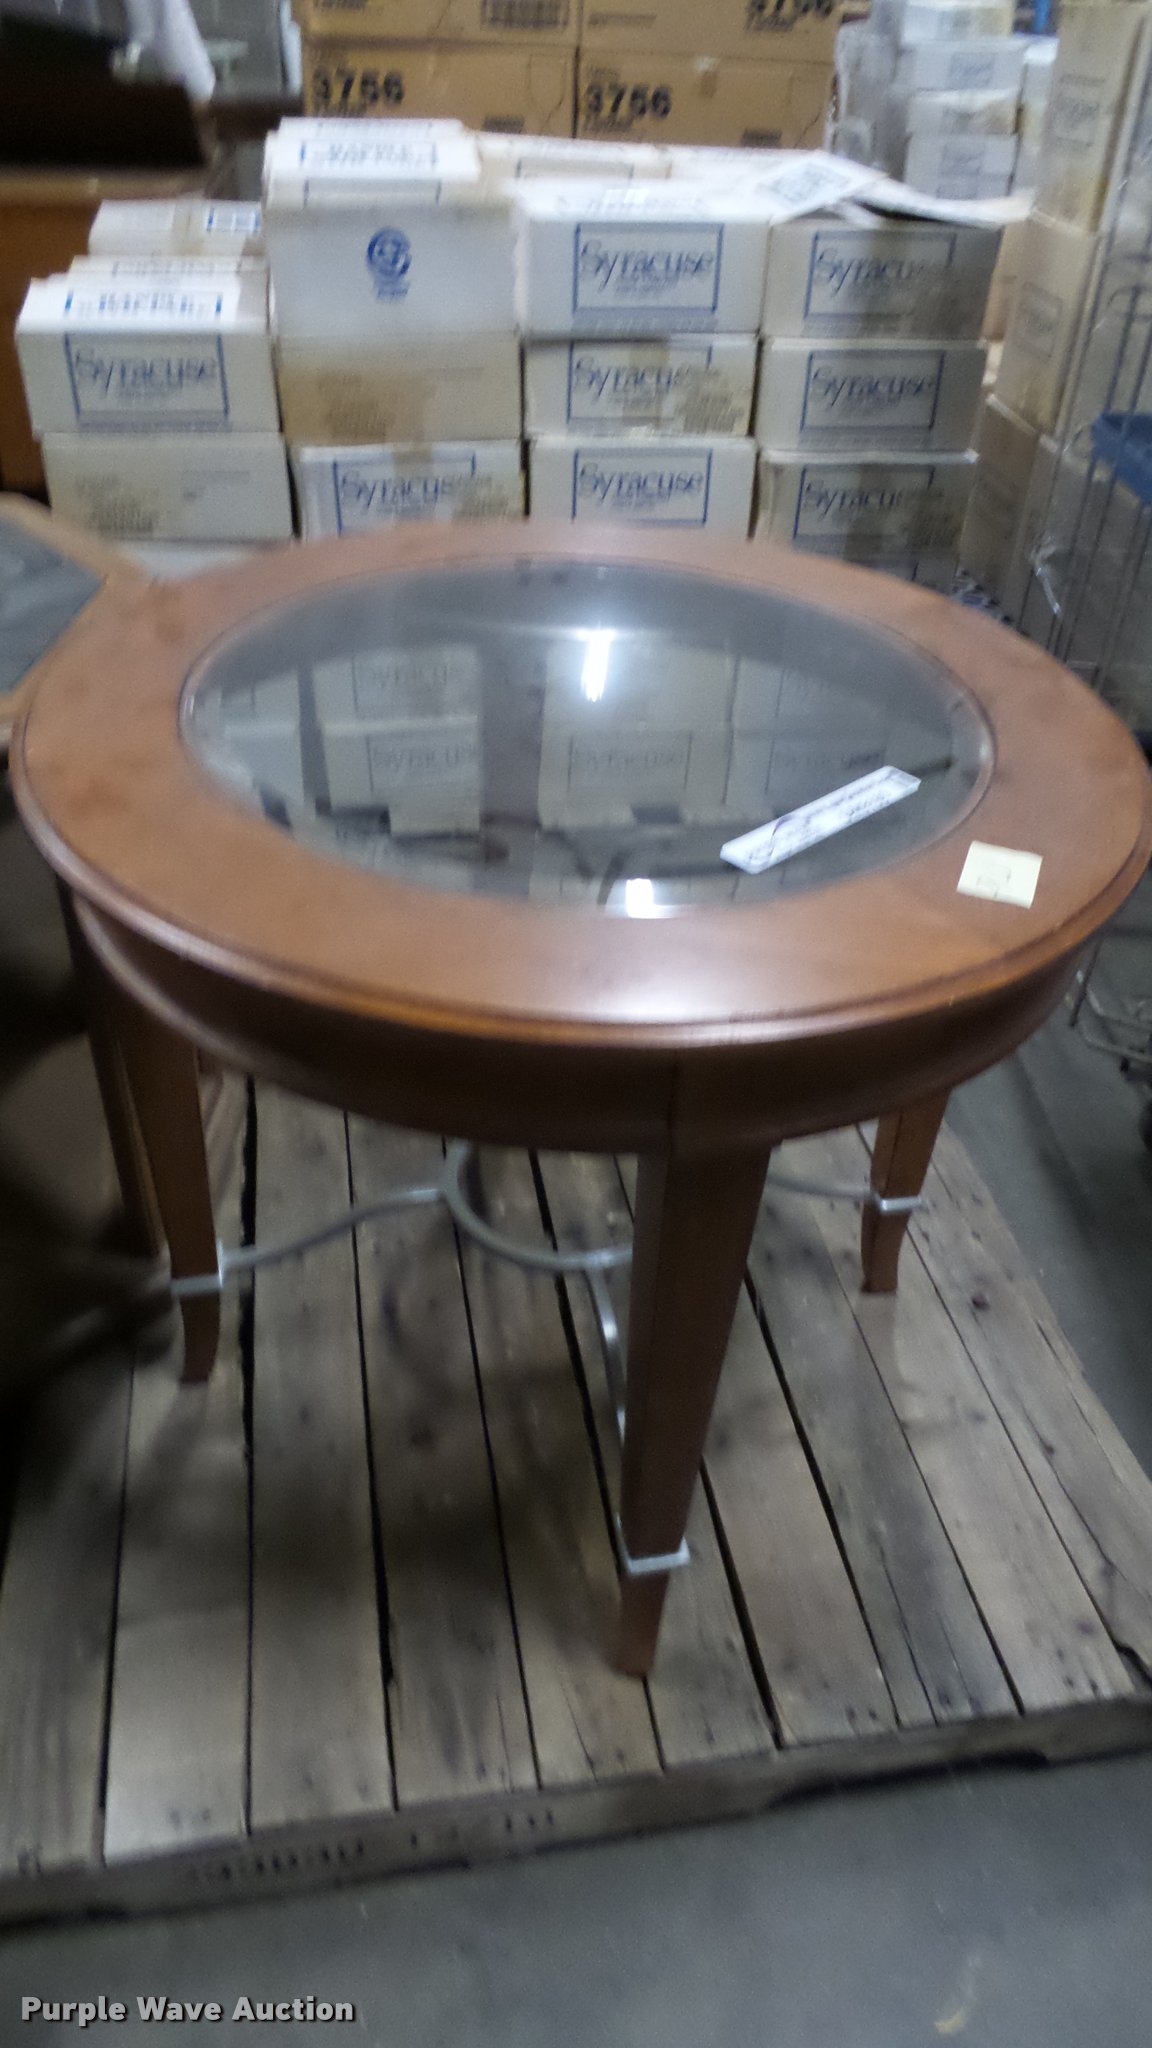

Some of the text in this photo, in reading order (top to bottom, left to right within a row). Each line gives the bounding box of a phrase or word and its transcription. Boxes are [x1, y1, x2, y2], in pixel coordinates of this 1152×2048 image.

[585, 82, 673, 120] 3756
[581, 240, 714, 291] Syracuse
[75, 350, 217, 396] Syracuse
[576, 357, 697, 404] Syracus
[813, 366, 932, 411] Syracuse
[342, 471, 460, 515] Syracus
[579, 462, 703, 506] Syracuse
[804, 480, 908, 522] Syracu
